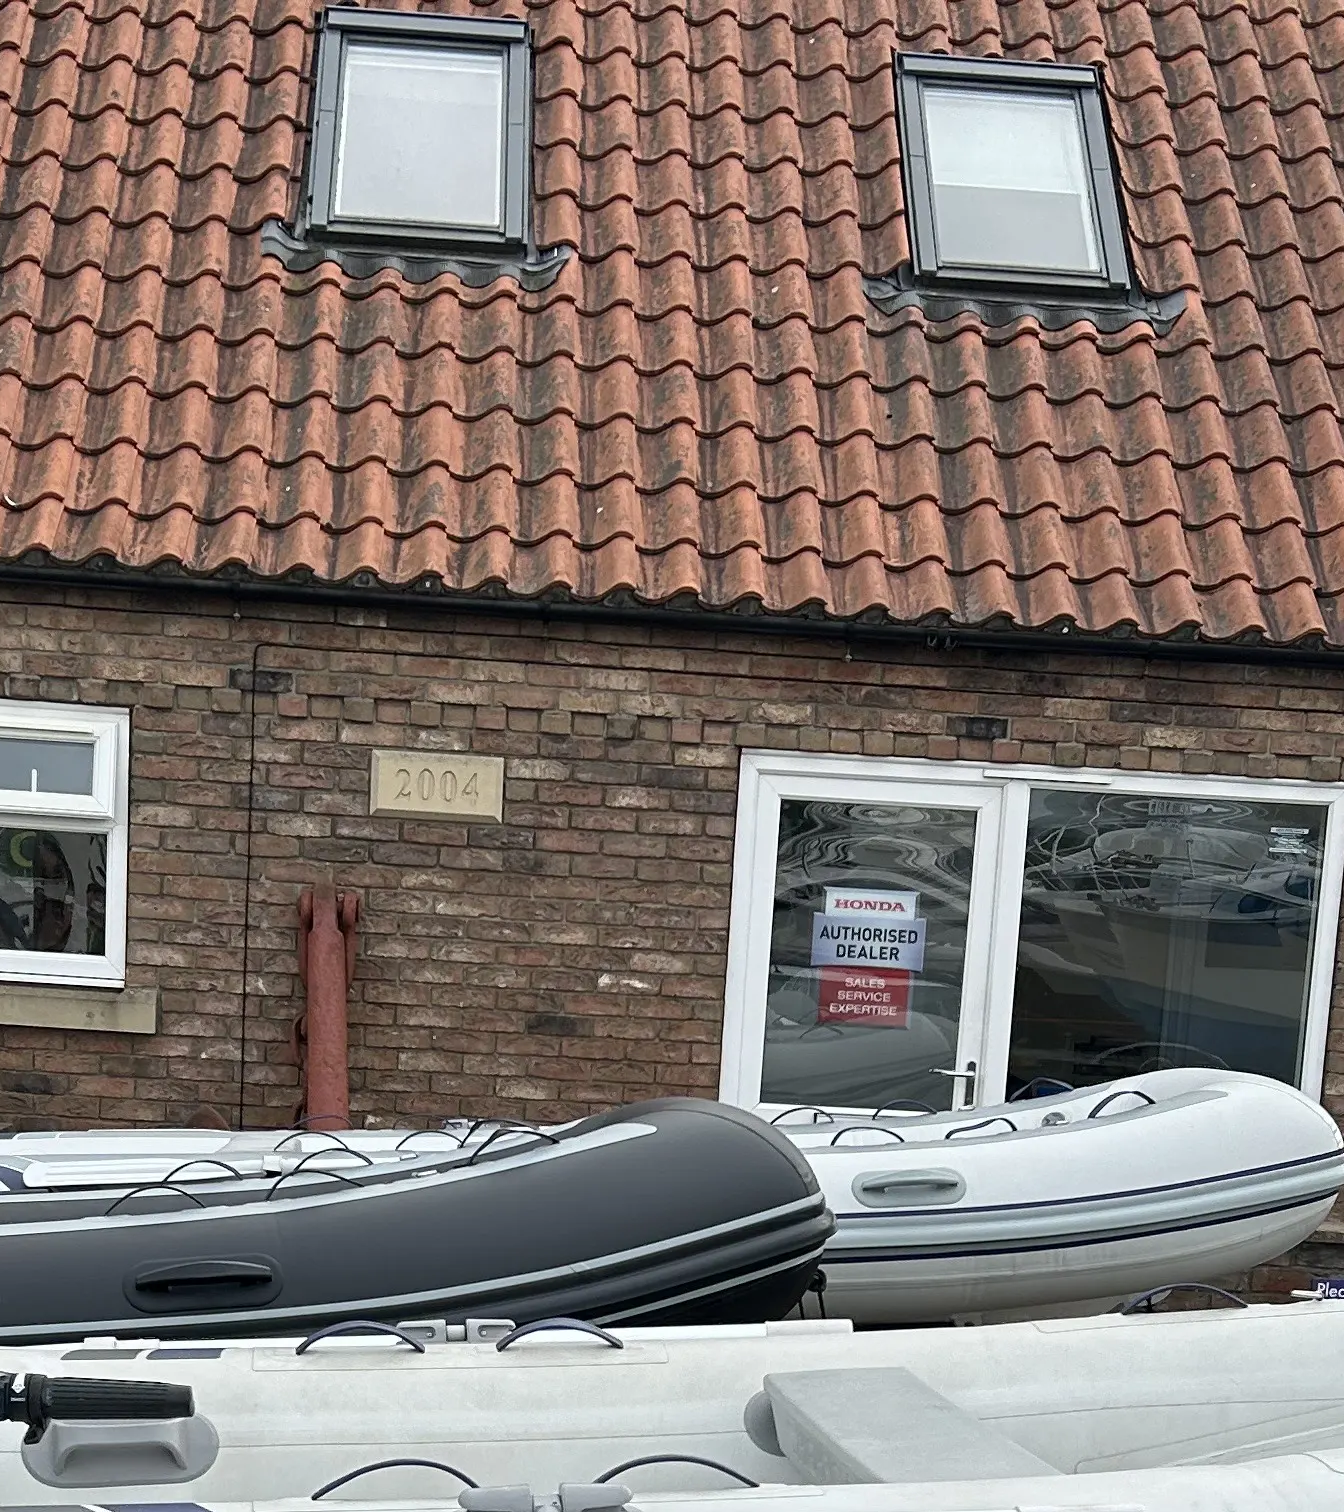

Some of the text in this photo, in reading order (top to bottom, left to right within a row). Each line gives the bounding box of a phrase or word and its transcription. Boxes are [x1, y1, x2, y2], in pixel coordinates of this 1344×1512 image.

[394, 768, 479, 804] 2004
[834, 899, 906, 912] HONDA
[820, 925, 918, 944] AUTHORISED
[836, 944, 900, 961] DEALER
[844, 977, 886, 989] SALES
[837, 990, 891, 1002] SERVICE
[829, 1003, 897, 1016] EXPERTISE
